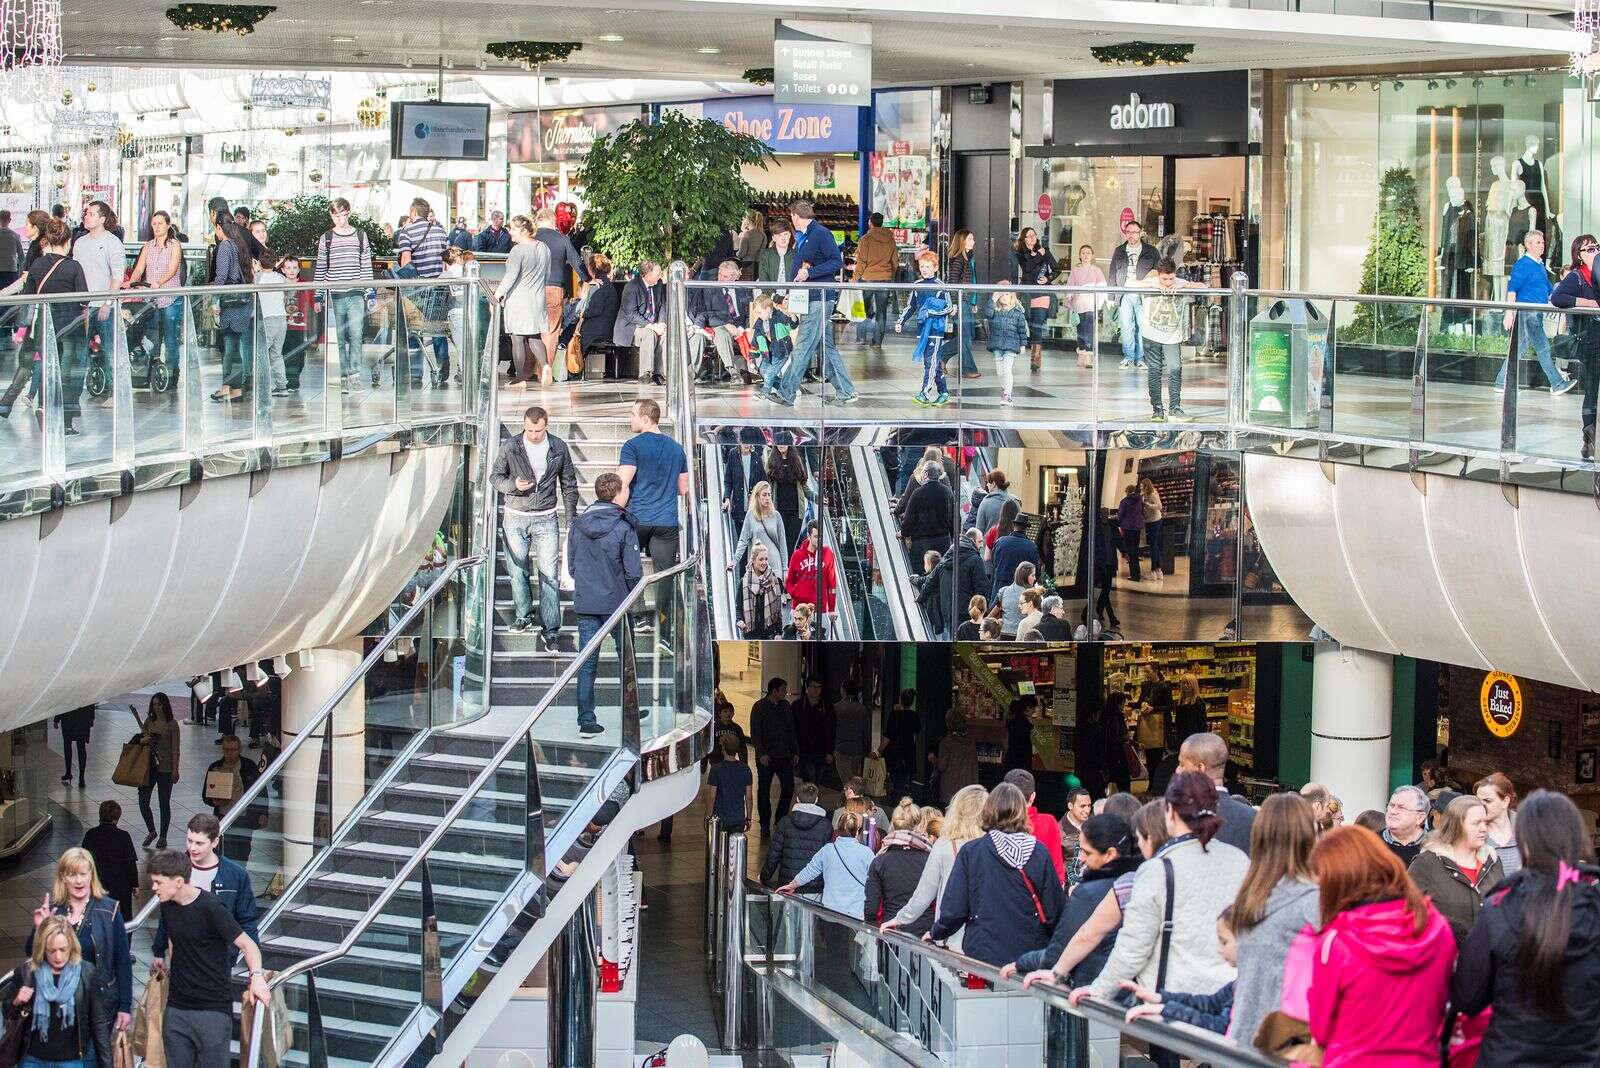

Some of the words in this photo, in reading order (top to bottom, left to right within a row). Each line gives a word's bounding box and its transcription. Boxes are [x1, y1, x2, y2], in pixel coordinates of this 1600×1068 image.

[793, 47, 825, 58] Dunnes
[793, 84, 821, 93] Toilets
[1110, 92, 1175, 130] adorn
[723, 110, 773, 141] Shoe
[777, 108, 832, 141] Zone
[1494, 685, 1509, 700] Just
[1490, 698, 1513, 715] Baked
